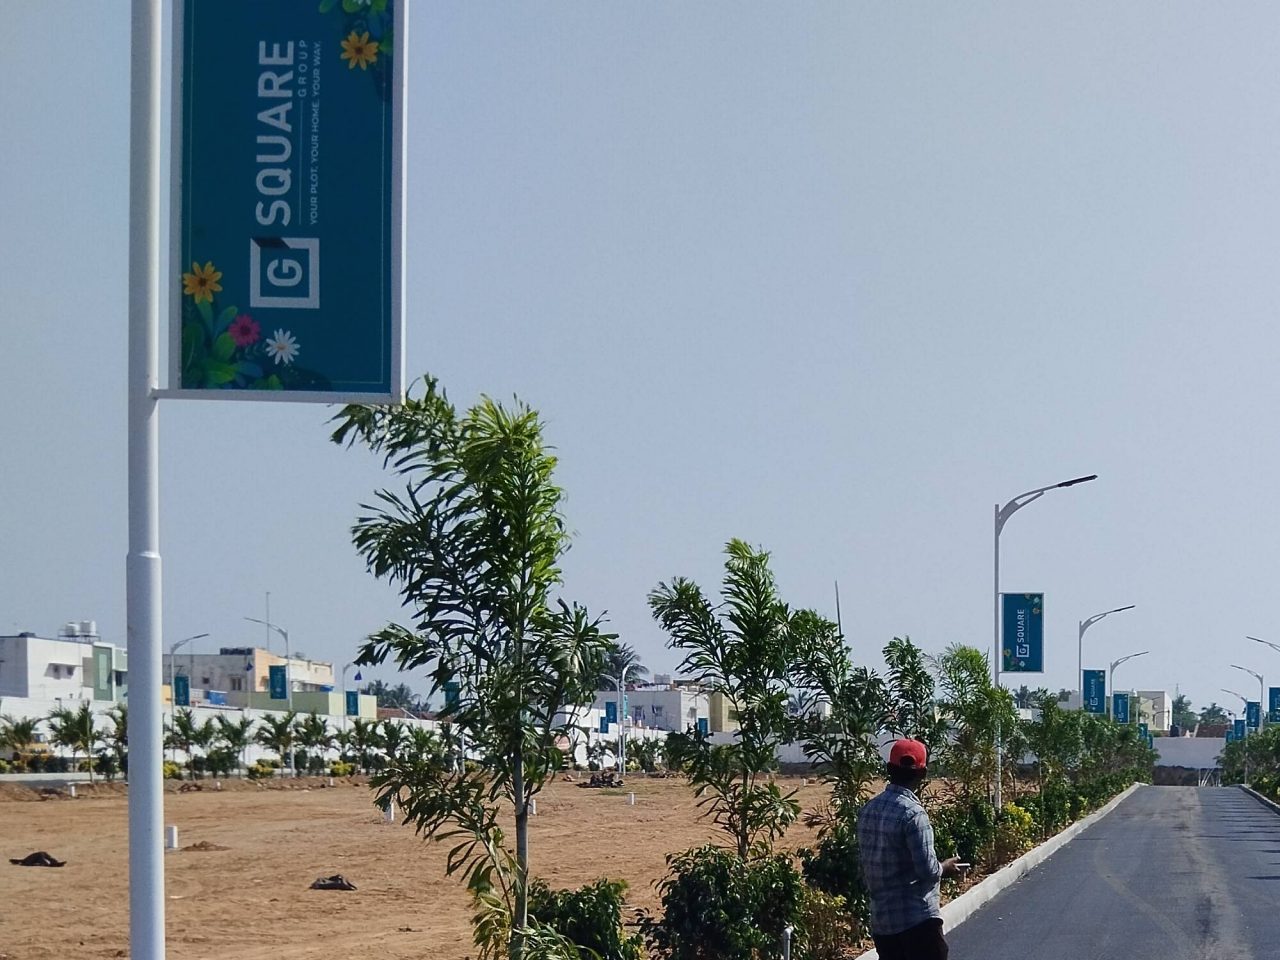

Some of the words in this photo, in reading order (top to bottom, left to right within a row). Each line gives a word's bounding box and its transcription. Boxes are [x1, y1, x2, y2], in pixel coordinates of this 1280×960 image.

[298, 39, 309, 98] GROUP
[312, 68, 321, 97] YOUR
[255, 40, 294, 227] SQUARE
[311, 134, 320, 164] YOUR
[310, 196, 319, 225] YOUR
[266, 258, 303, 288] G
[1017, 609, 1025, 643] SQUARE
